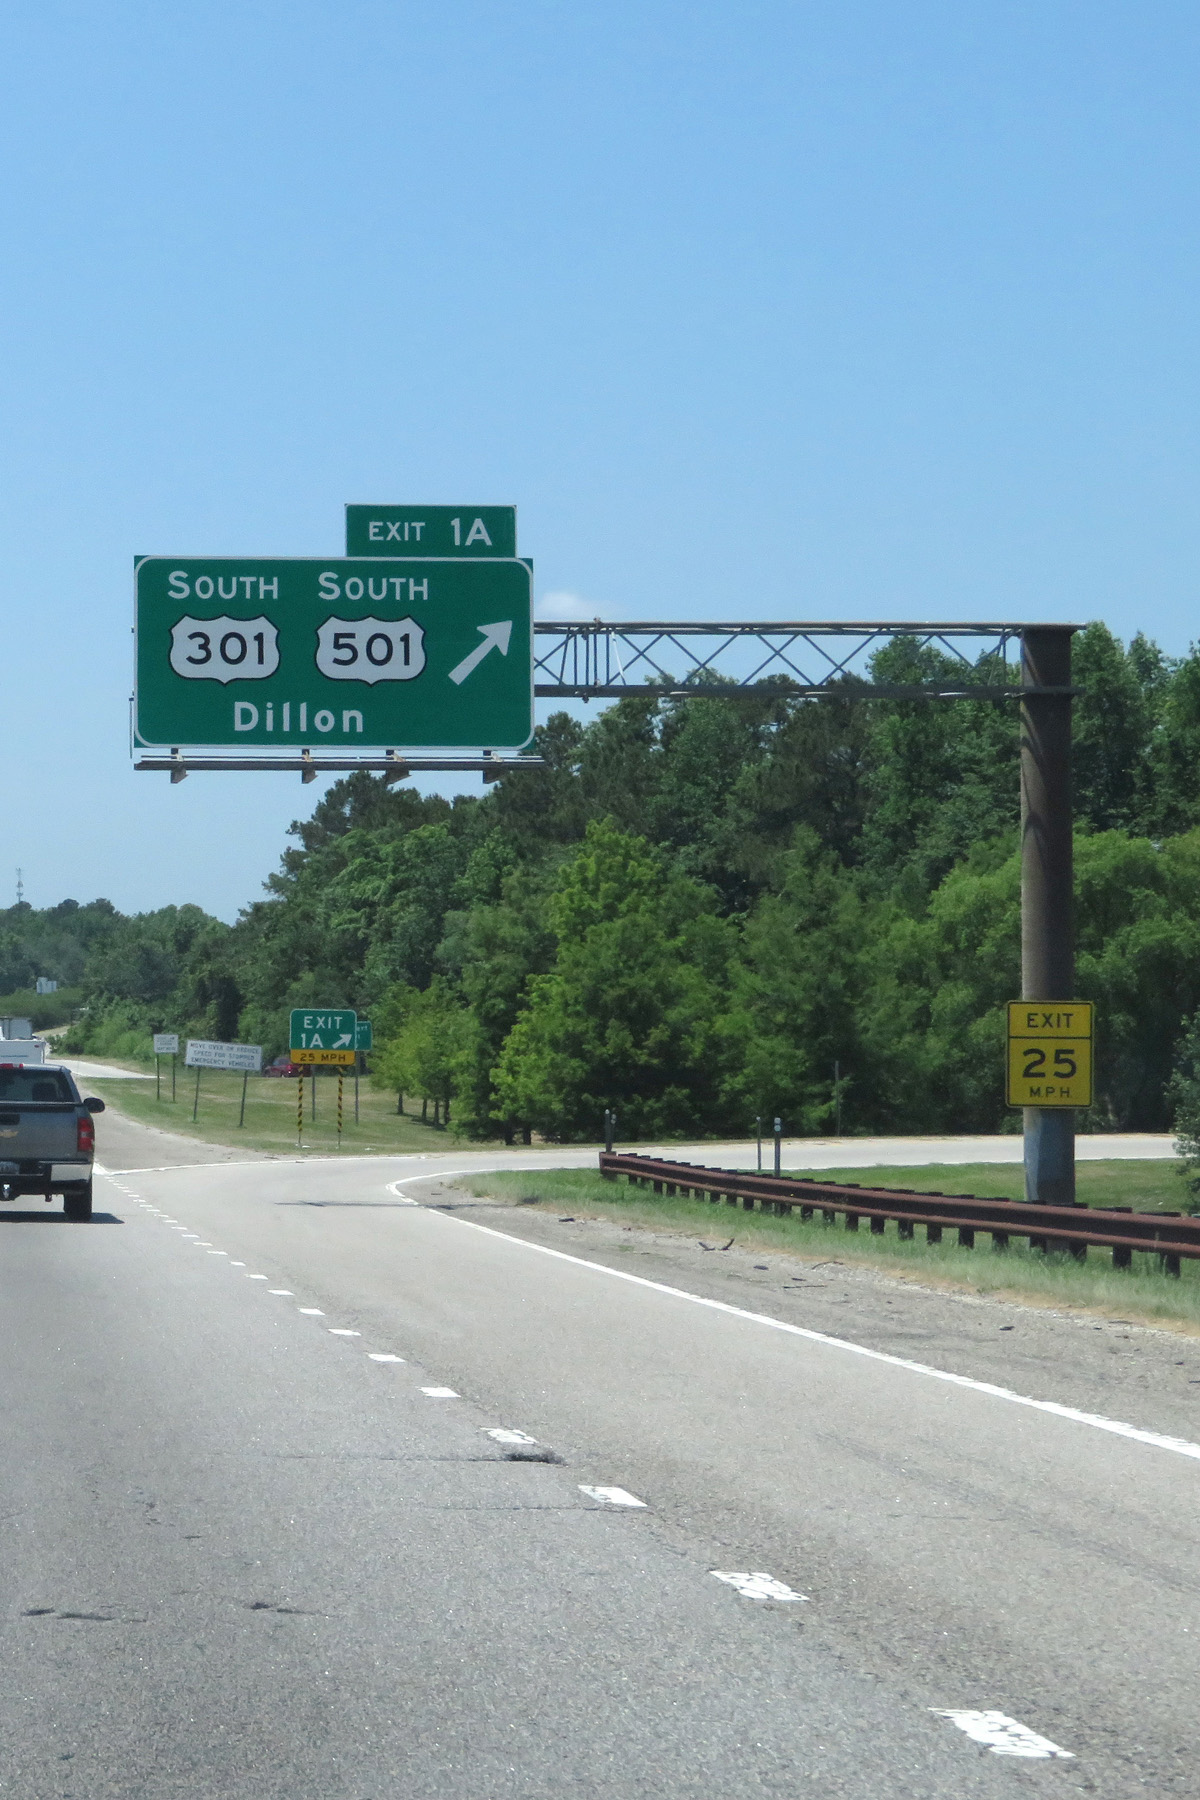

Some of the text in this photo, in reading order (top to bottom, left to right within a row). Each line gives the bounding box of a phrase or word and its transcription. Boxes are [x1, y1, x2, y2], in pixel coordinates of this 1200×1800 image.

[368, 517, 493, 546] EXIT 1A
[167, 570, 429, 601] SOUTH SOUTH
[185, 631, 411, 667] 301 501
[234, 701, 364, 733] Dillon
[303, 1016, 343, 1029] EXIT
[1027, 1013, 1074, 1028] EXIT
[300, 1033, 324, 1049] 1A
[300, 1053, 346, 1062] 25 MPH
[1022, 1048, 1078, 1079] 25
